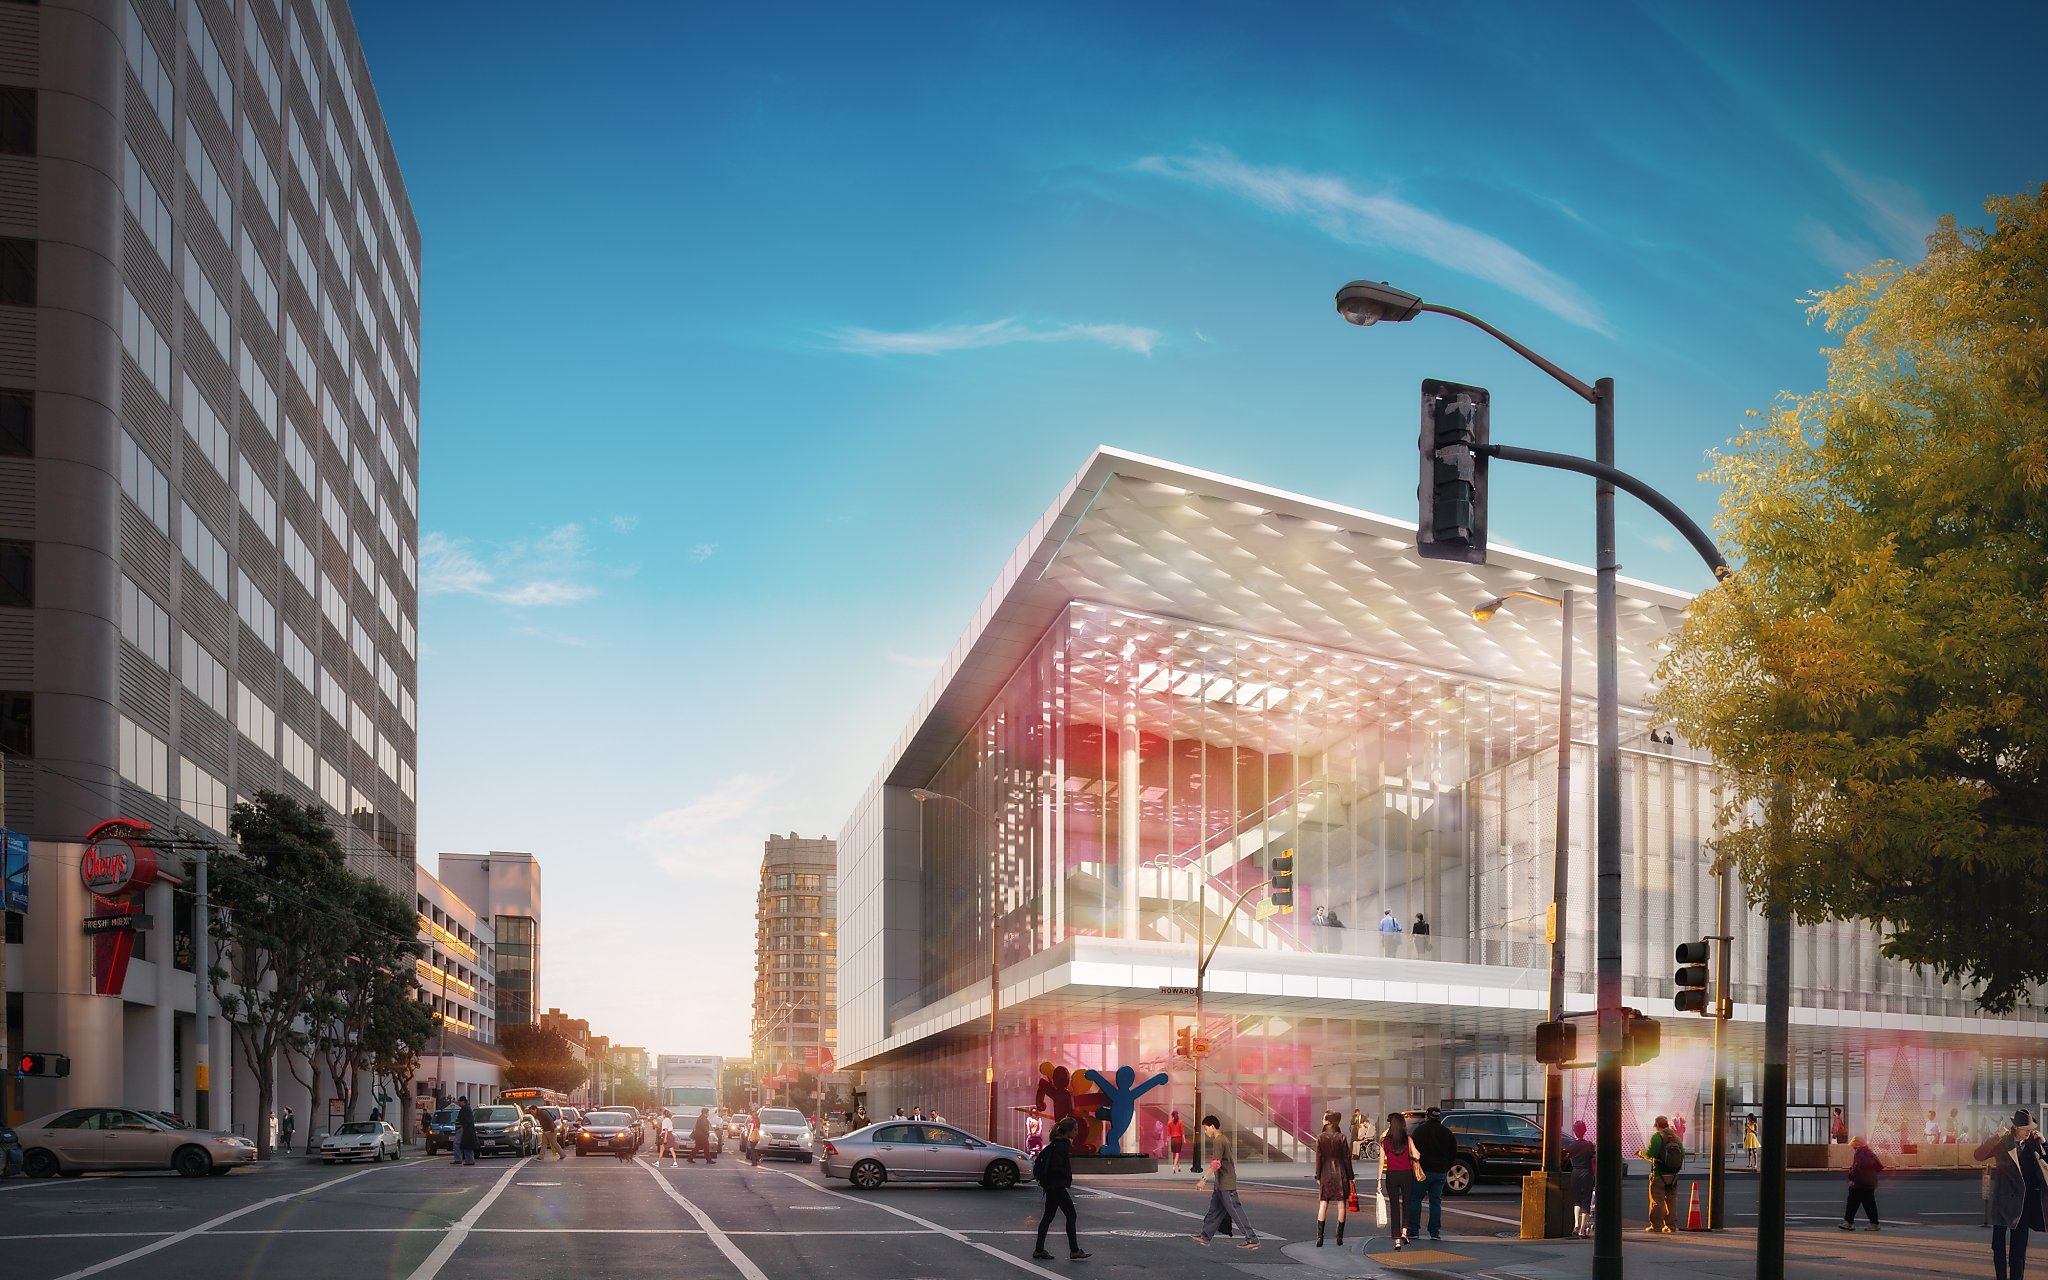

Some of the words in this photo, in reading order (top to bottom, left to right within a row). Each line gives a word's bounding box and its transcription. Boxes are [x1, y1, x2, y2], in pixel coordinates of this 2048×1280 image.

[85, 847, 126, 882] Chevys
[82, 919, 107, 929] FRESH
[1161, 987, 1195, 995] HOWARD
